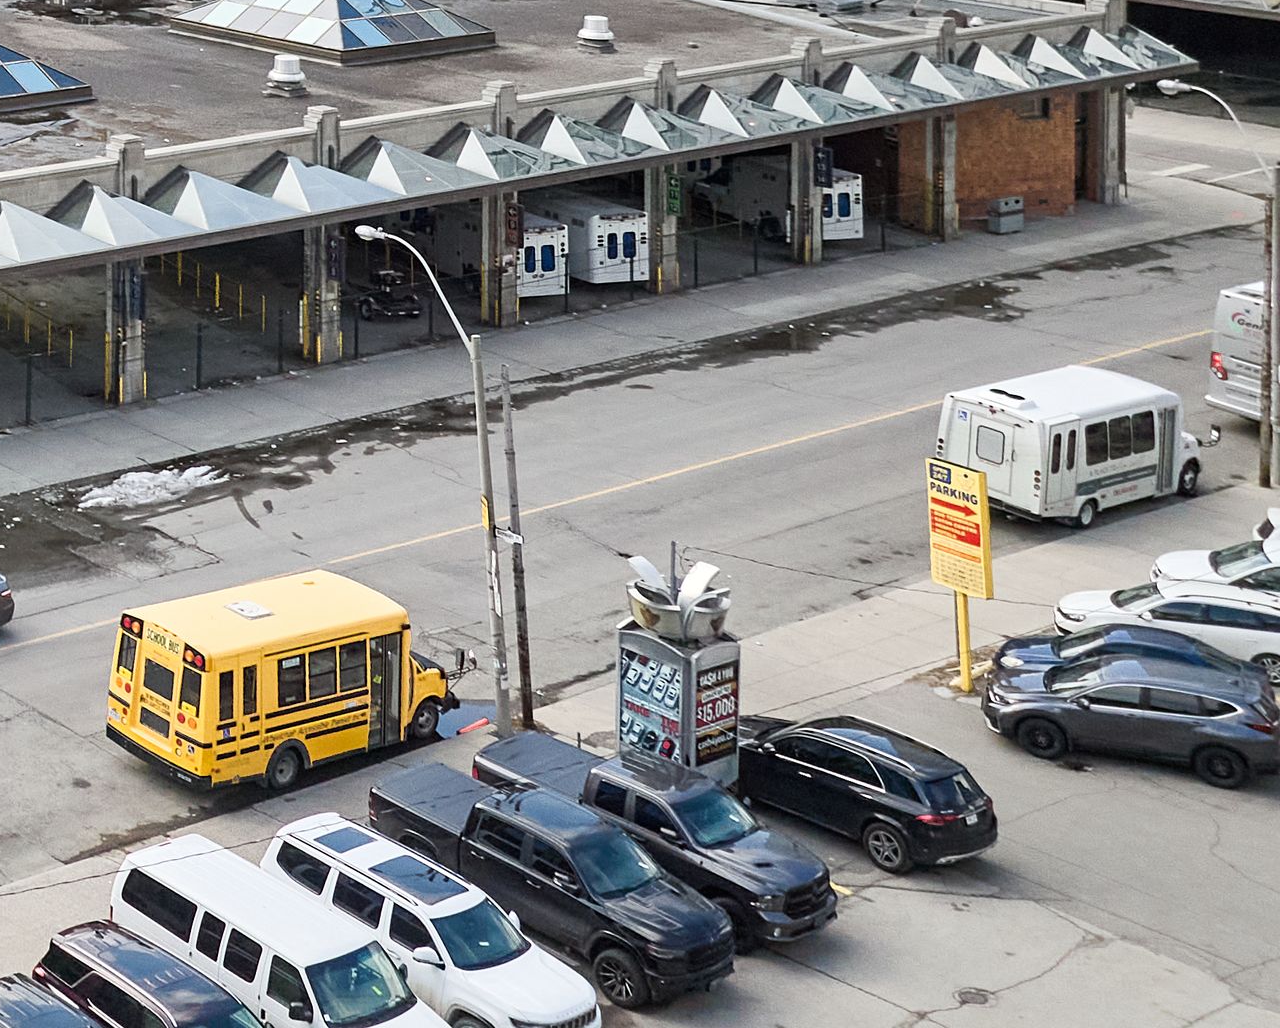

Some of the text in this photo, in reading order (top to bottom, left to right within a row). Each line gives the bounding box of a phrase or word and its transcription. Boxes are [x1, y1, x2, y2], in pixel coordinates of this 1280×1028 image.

[930, 481, 978, 505] PARKING
[146, 628, 180, 655] SCHOOL BUS
